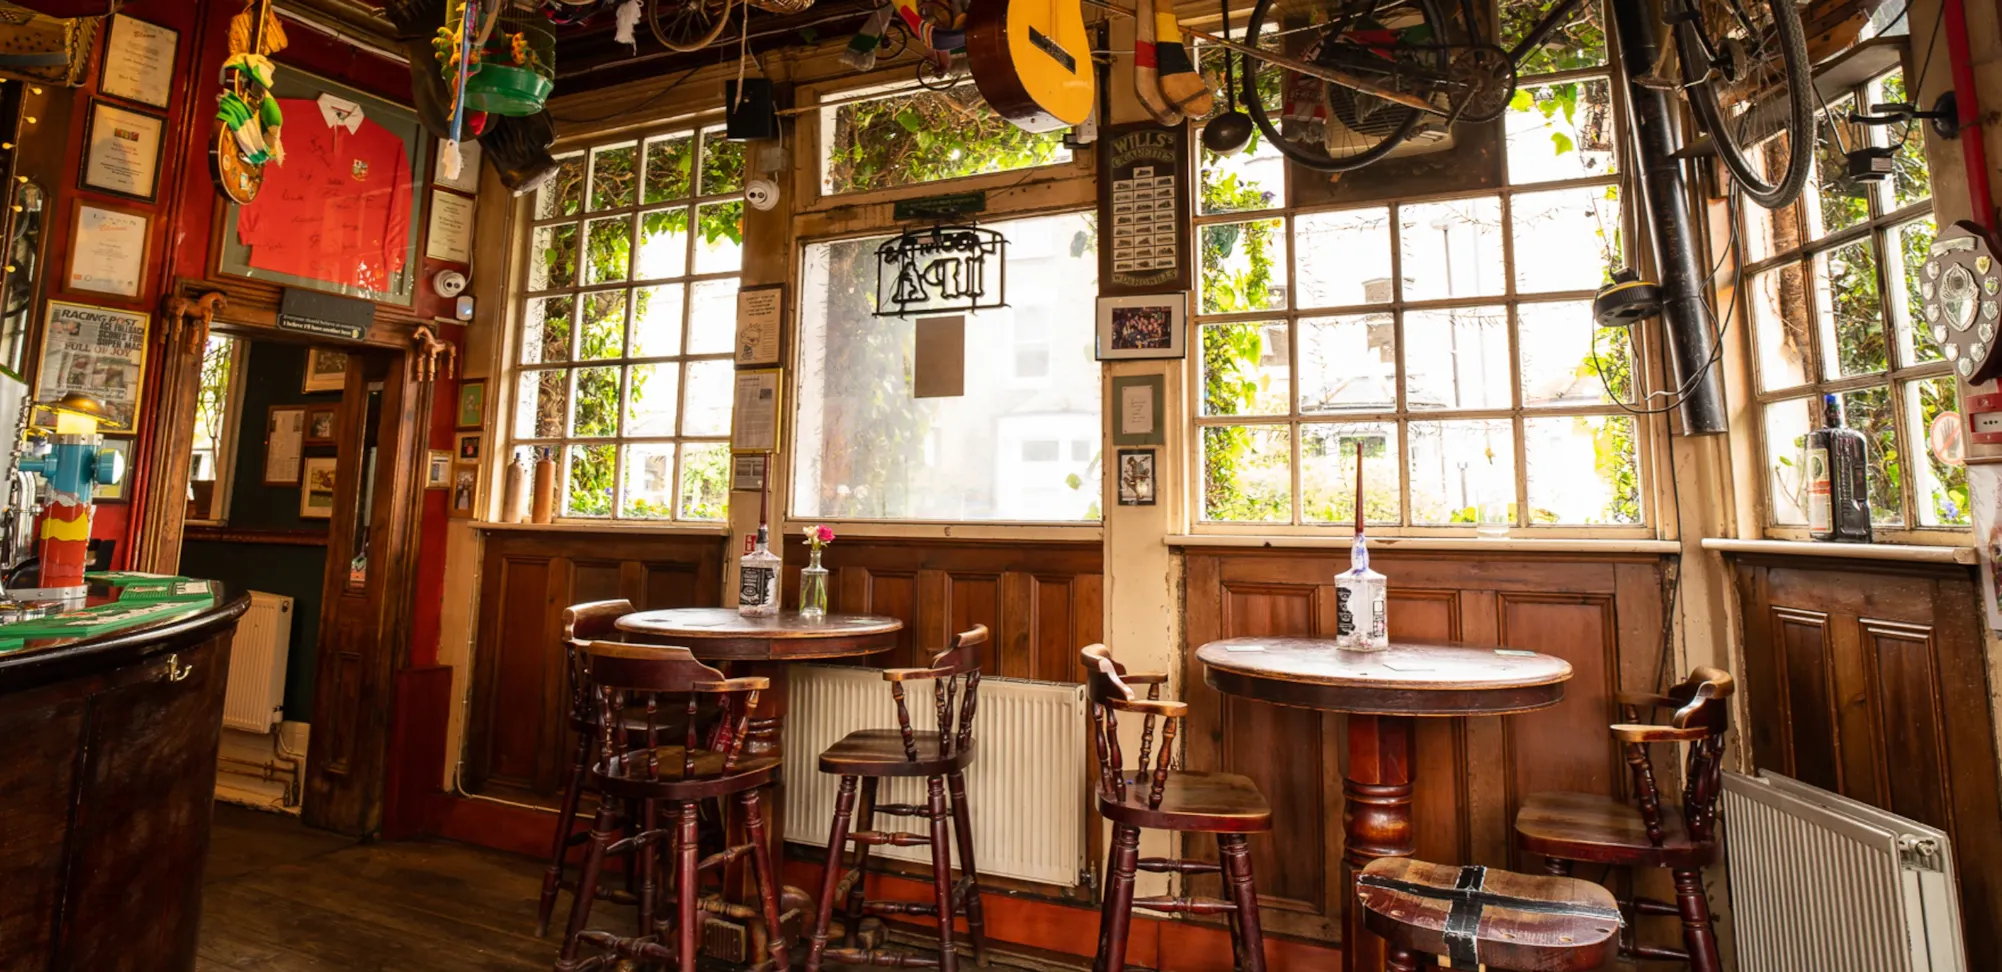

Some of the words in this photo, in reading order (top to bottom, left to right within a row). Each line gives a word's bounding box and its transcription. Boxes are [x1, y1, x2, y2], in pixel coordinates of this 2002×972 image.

[62, 309, 106, 322] RACING
[109, 316, 138, 326] POST
[64, 343, 91, 353] FULL
[94, 346, 109, 354] OF
[110, 348, 132, 357] JOY
[97, 338, 122, 348] SUPER
